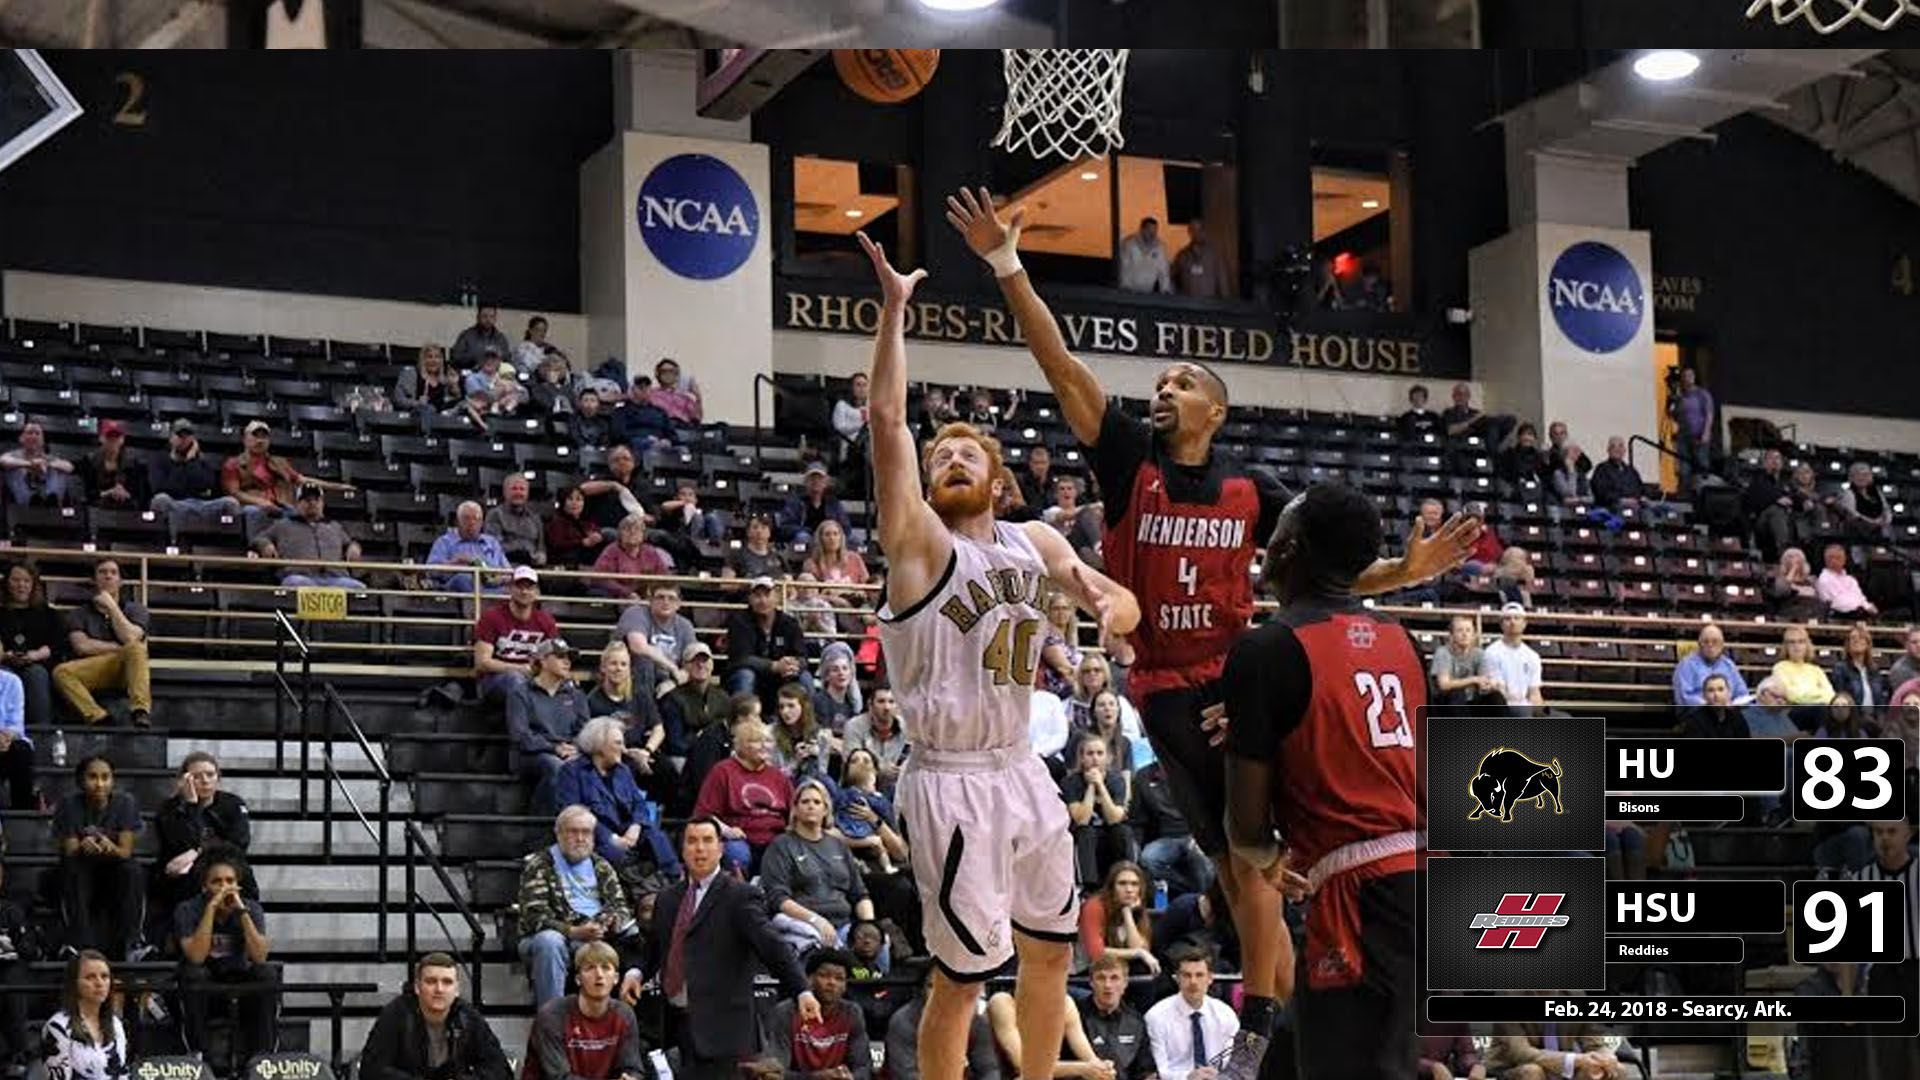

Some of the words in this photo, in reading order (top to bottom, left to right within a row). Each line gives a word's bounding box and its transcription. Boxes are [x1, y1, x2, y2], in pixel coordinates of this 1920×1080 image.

[114, 71, 147, 125] 2
[642, 195, 752, 236] NCAA
[1553, 278, 1639, 315] NCAA
[1155, 321, 1274, 362] FIELD
[1289, 330, 1420, 372] HOUSE
[1138, 513, 1246, 548] HENDERSON
[1178, 557, 1198, 596] 4
[300, 591, 344, 613] VISITOR
[1159, 604, 1213, 630] STATE
[983, 618, 1040, 685] 40
[1353, 670, 1414, 748] 23
[160, 1062, 202, 1080] Unity
[278, 1060, 322, 1077] Unity
